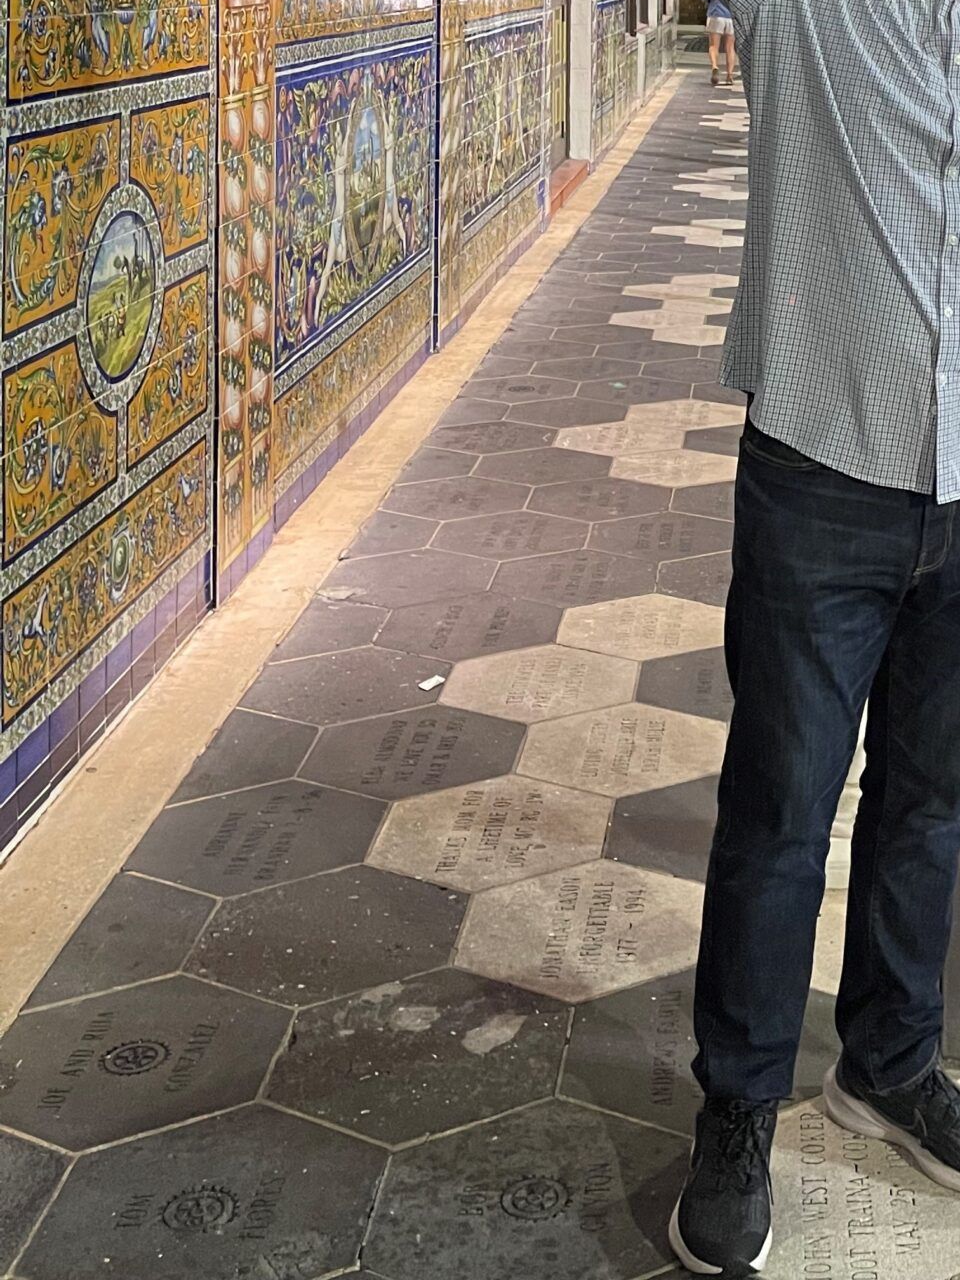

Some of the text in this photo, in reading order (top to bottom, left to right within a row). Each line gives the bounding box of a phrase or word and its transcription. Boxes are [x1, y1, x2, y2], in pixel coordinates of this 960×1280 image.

[801, 1112, 826, 1165] COKER
[457, 1184, 490, 1216] BOB
[802, 1176, 828, 1223] WEST
[893, 1219, 921, 1255] MAY
